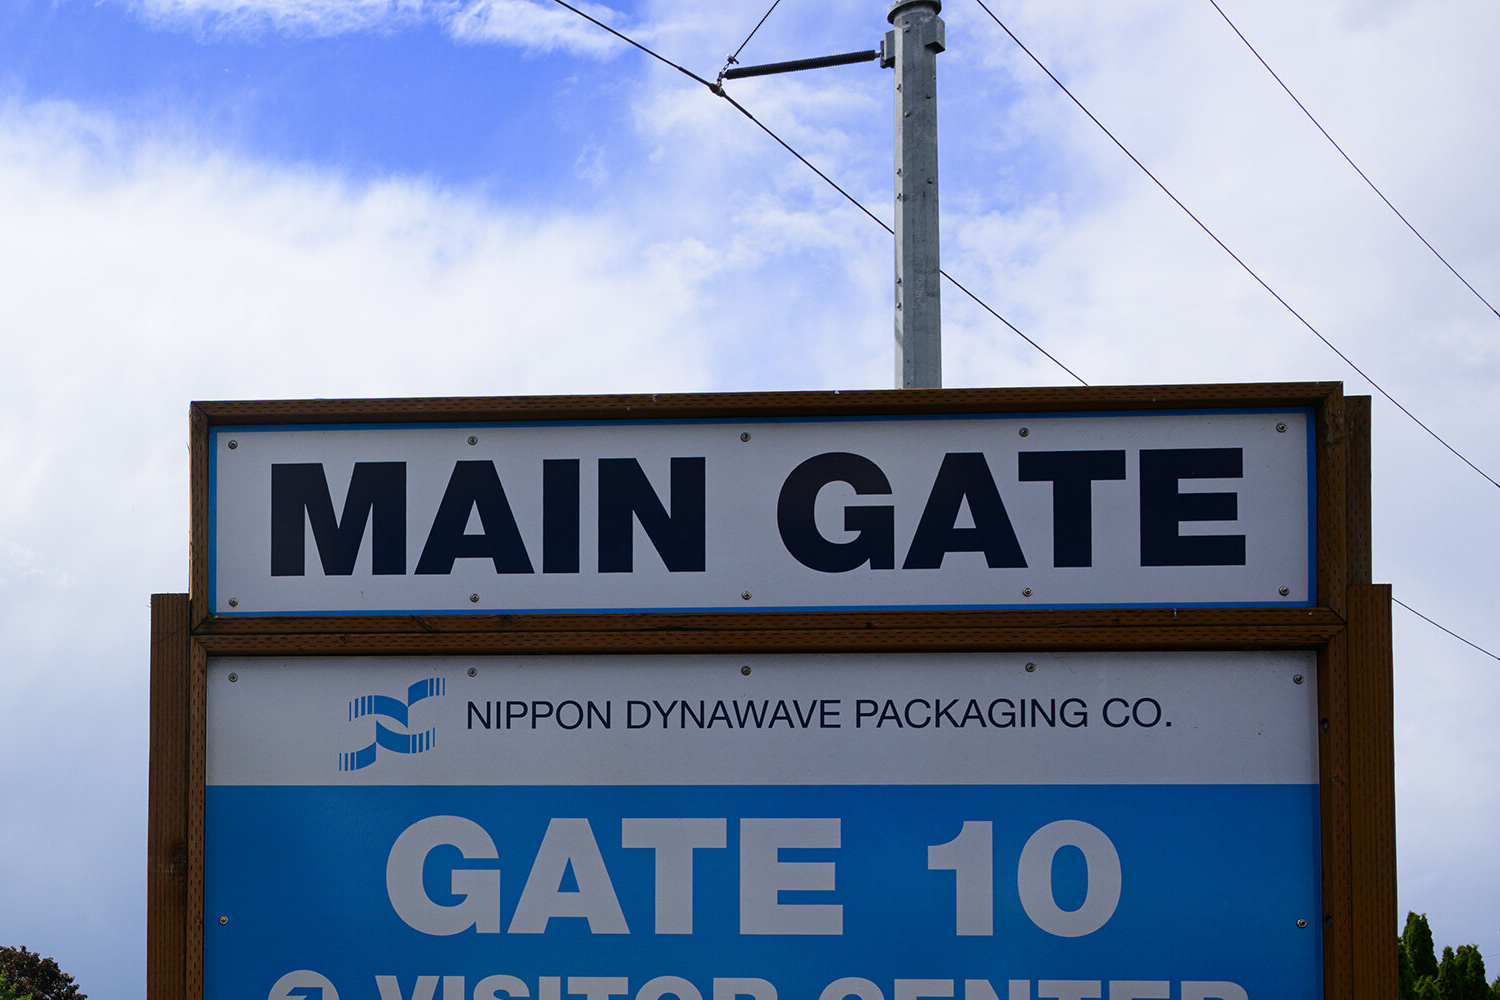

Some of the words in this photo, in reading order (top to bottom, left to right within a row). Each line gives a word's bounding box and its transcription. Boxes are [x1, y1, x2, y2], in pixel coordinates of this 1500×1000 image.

[270, 456, 706, 577] MAIN
[776, 447, 1247, 574] GATE
[467, 699, 611, 730] NIPPON
[626, 699, 842, 729] DYNAWAVE
[855, 697, 1088, 729] PACKAGING
[1102, 696, 1172, 728] CO.
[385, 814, 844, 937] GATE
[927, 819, 1122, 938] 10
